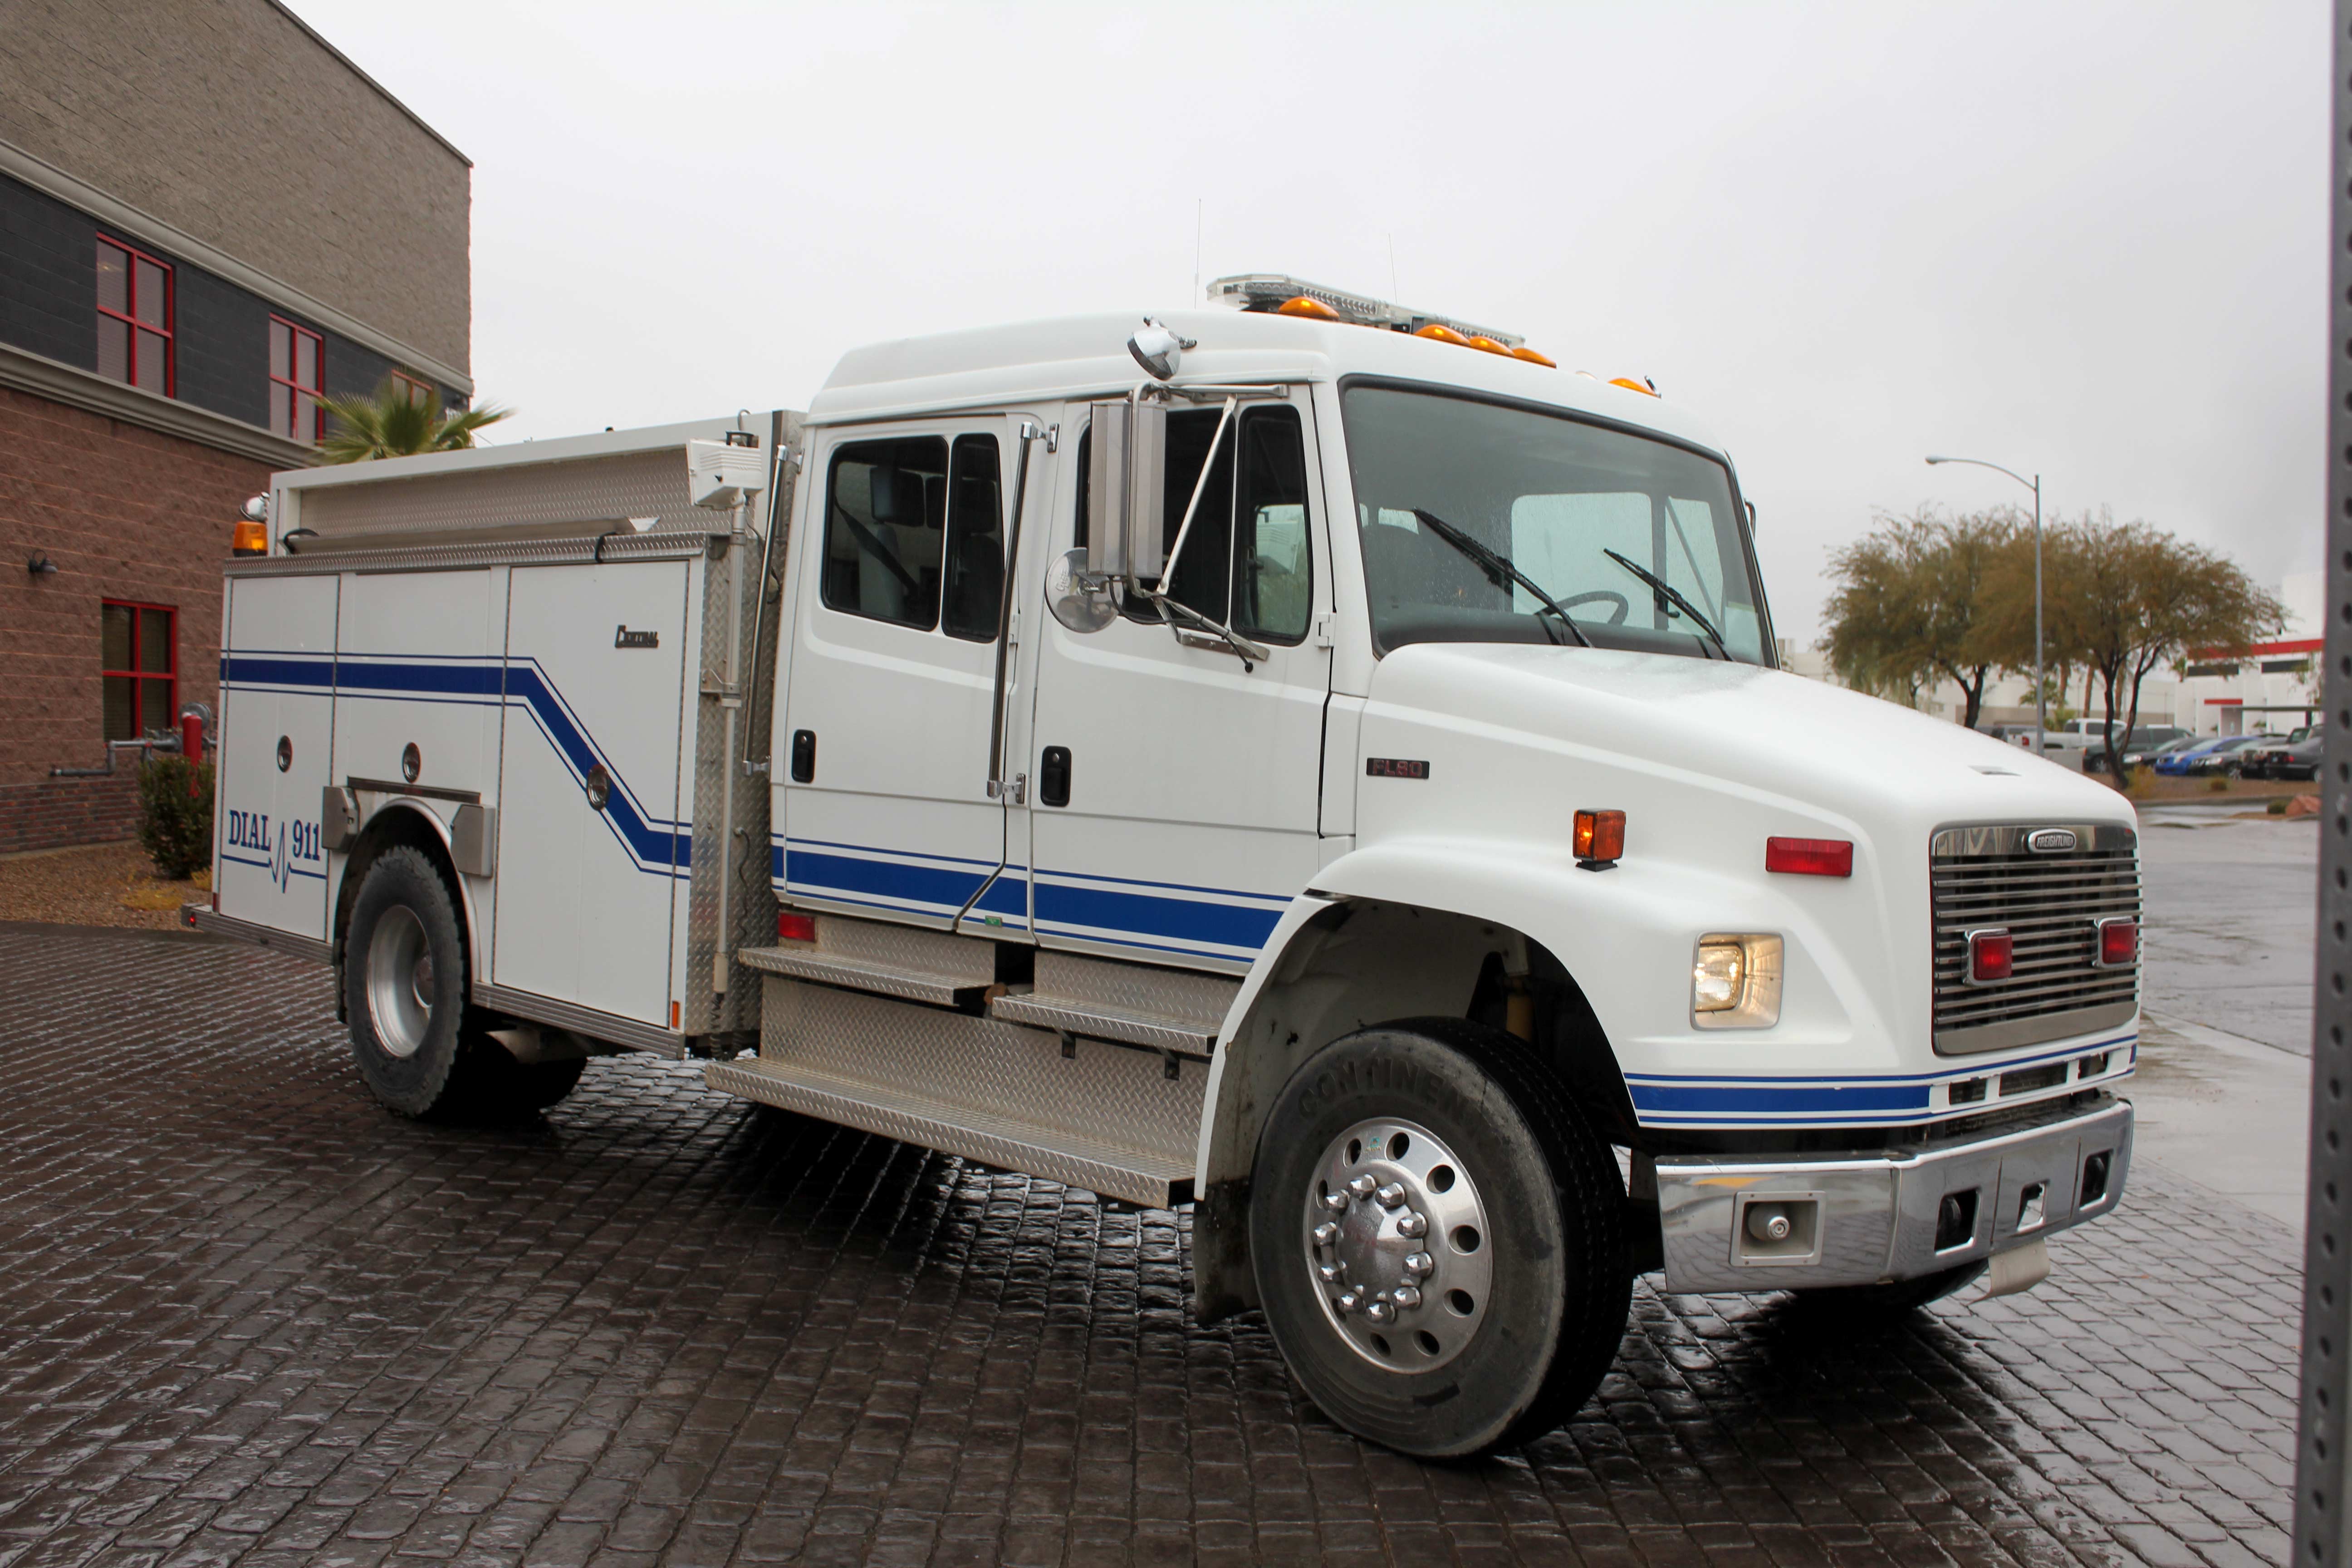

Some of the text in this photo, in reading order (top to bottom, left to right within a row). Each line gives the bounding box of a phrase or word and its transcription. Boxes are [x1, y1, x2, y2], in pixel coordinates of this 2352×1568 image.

[1372, 759, 1423, 777] FL80
[228, 809, 320, 861] DIAL 911
[2036, 834, 2074, 848] FREIGHTLINER
